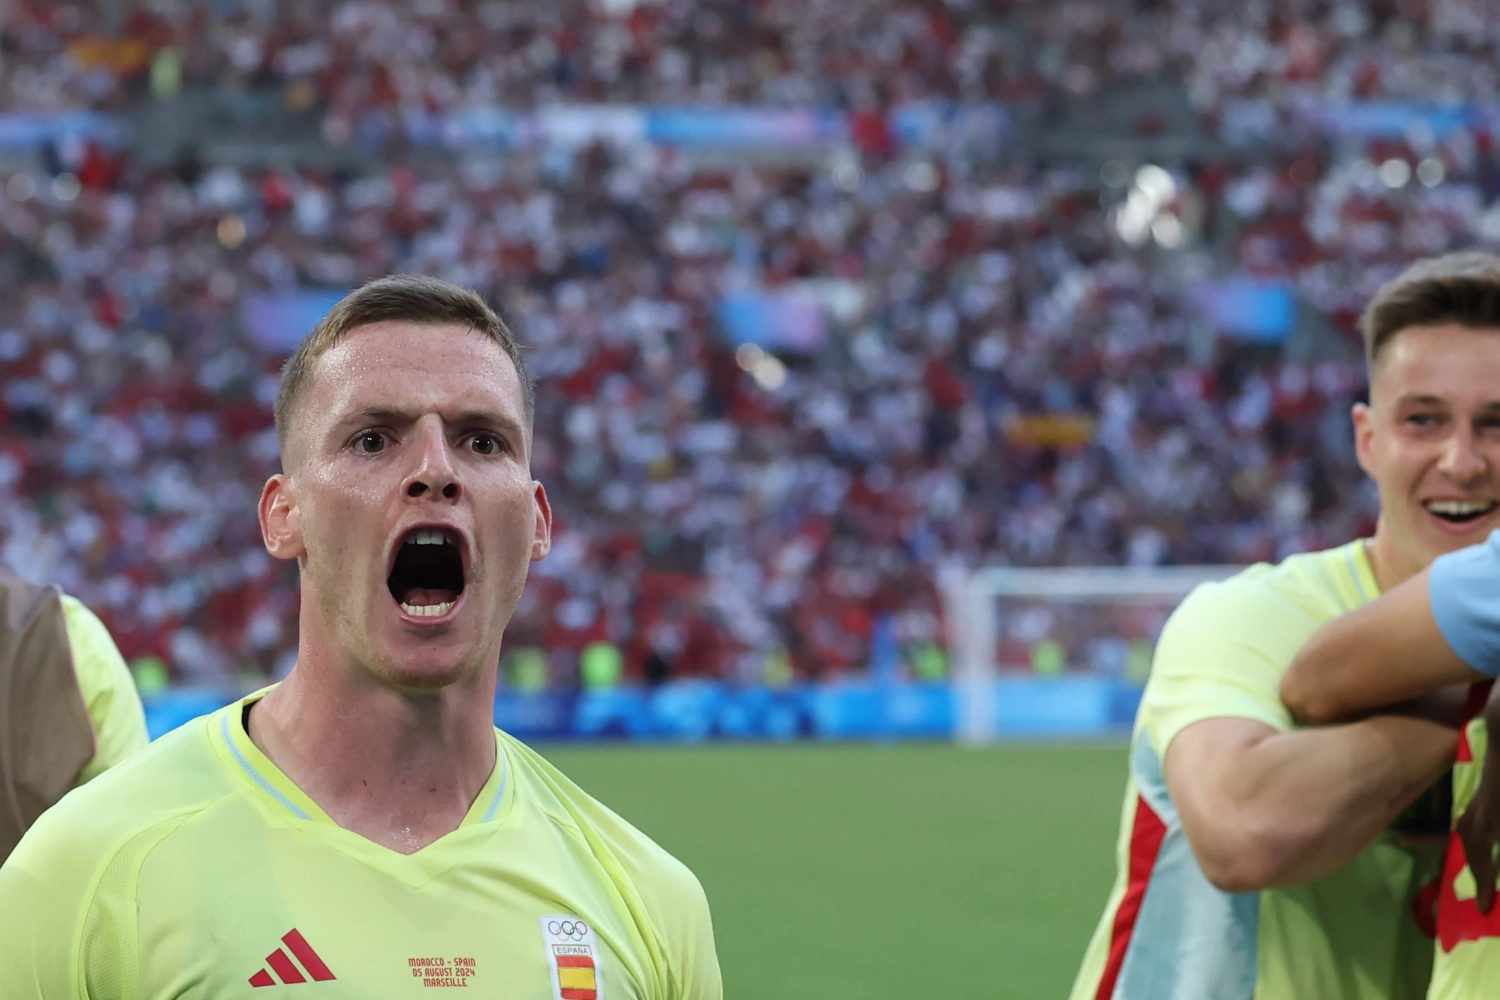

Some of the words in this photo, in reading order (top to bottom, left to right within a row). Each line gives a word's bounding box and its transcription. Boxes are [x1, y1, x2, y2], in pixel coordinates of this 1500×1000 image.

[556, 946, 589, 955] ESPAÑA
[408, 957, 445, 967] MOROCCO
[454, 957, 476, 967] SPAIN
[412, 968, 422, 977] 05
[425, 967, 452, 977] AUGUST
[455, 968, 475, 977] 2024
[423, 978, 467, 987] MARSEILLE
